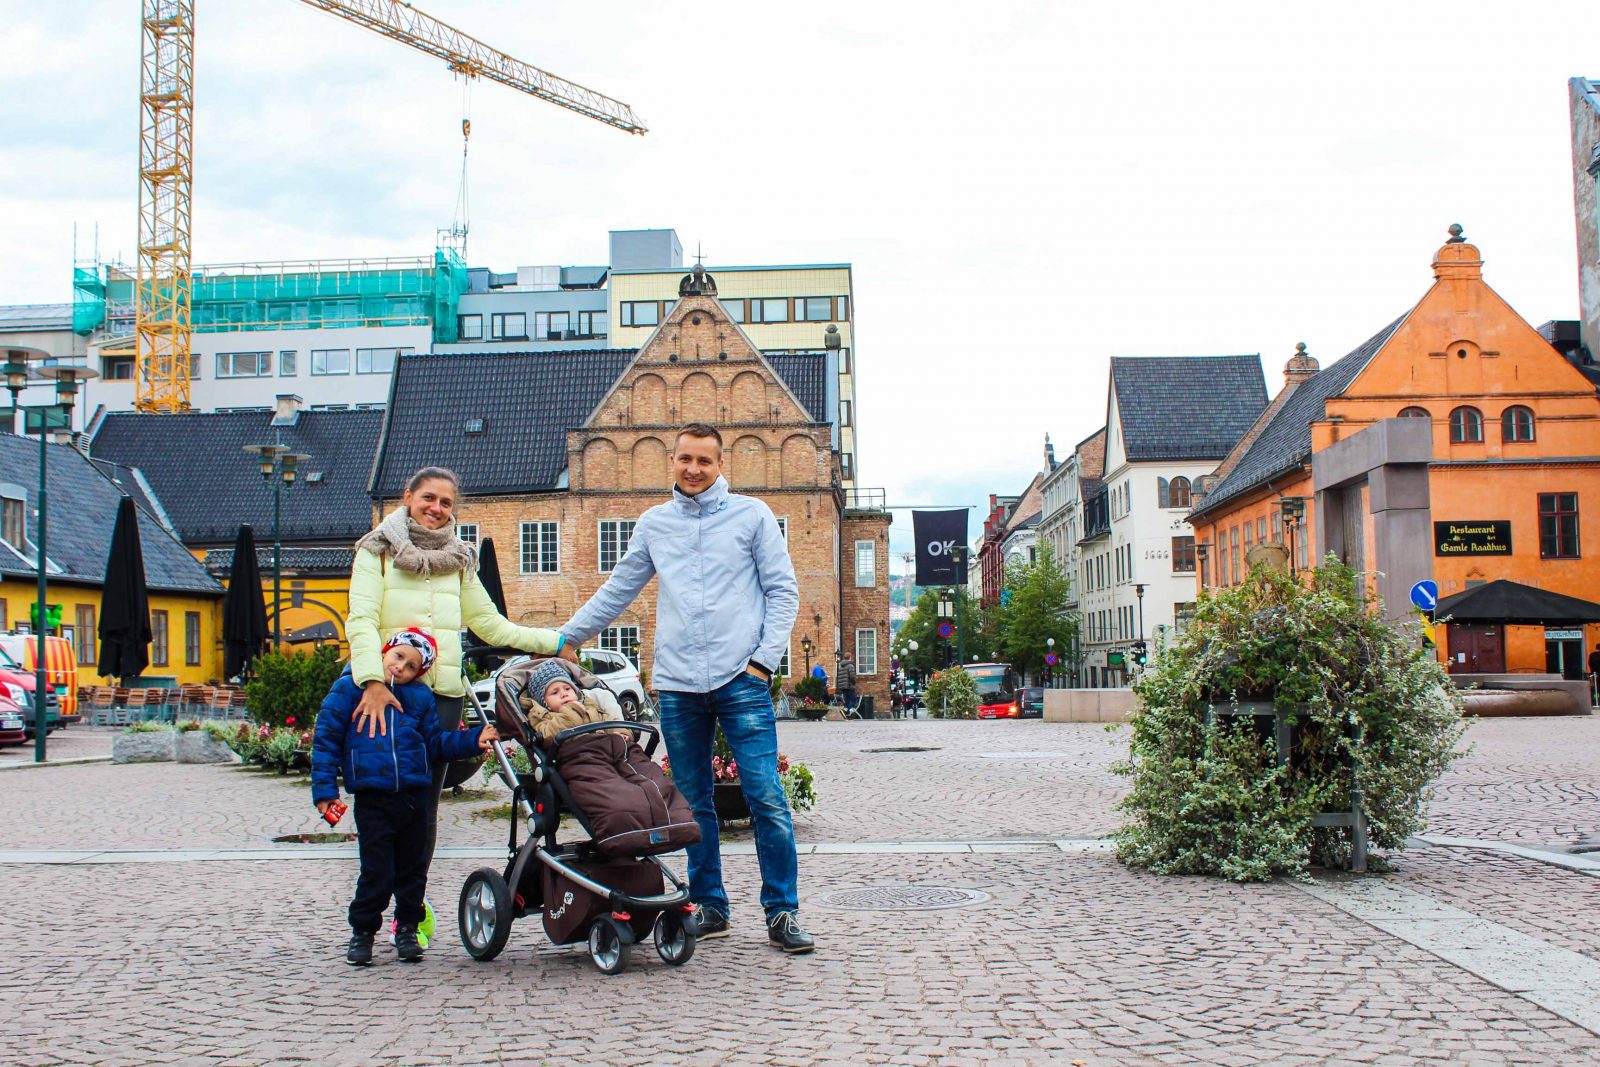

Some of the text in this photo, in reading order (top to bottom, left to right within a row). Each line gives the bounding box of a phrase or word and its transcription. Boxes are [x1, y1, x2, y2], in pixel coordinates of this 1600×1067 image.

[1449, 524, 1495, 534] Restaurant
[927, 540, 956, 557] OK
[1440, 542, 1507, 552] Gamle Raadhus
